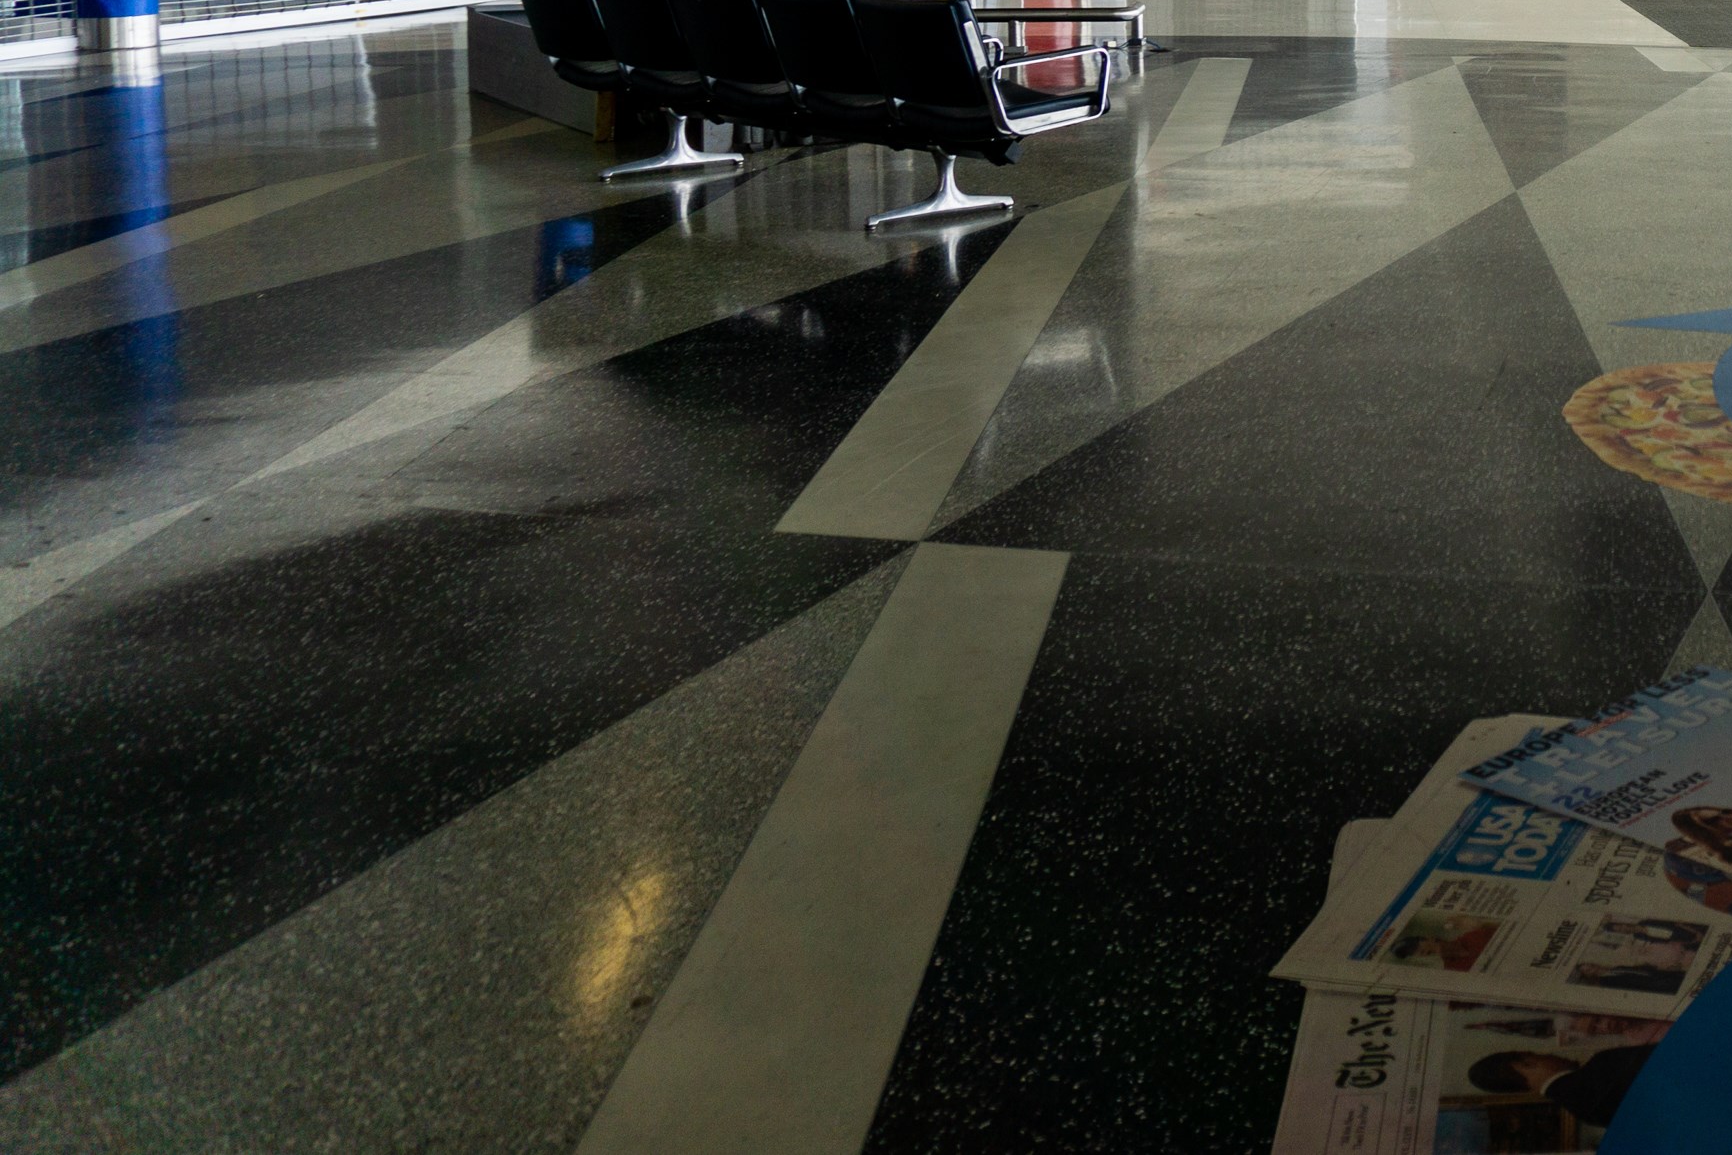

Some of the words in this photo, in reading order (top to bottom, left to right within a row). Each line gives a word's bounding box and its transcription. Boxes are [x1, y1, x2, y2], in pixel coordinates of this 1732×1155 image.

[1467, 722, 1577, 780] EUROPE
[1465, 803, 1530, 847] USA
[1491, 811, 1565, 873] TODA
[1335, 1037, 1395, 1089] The
